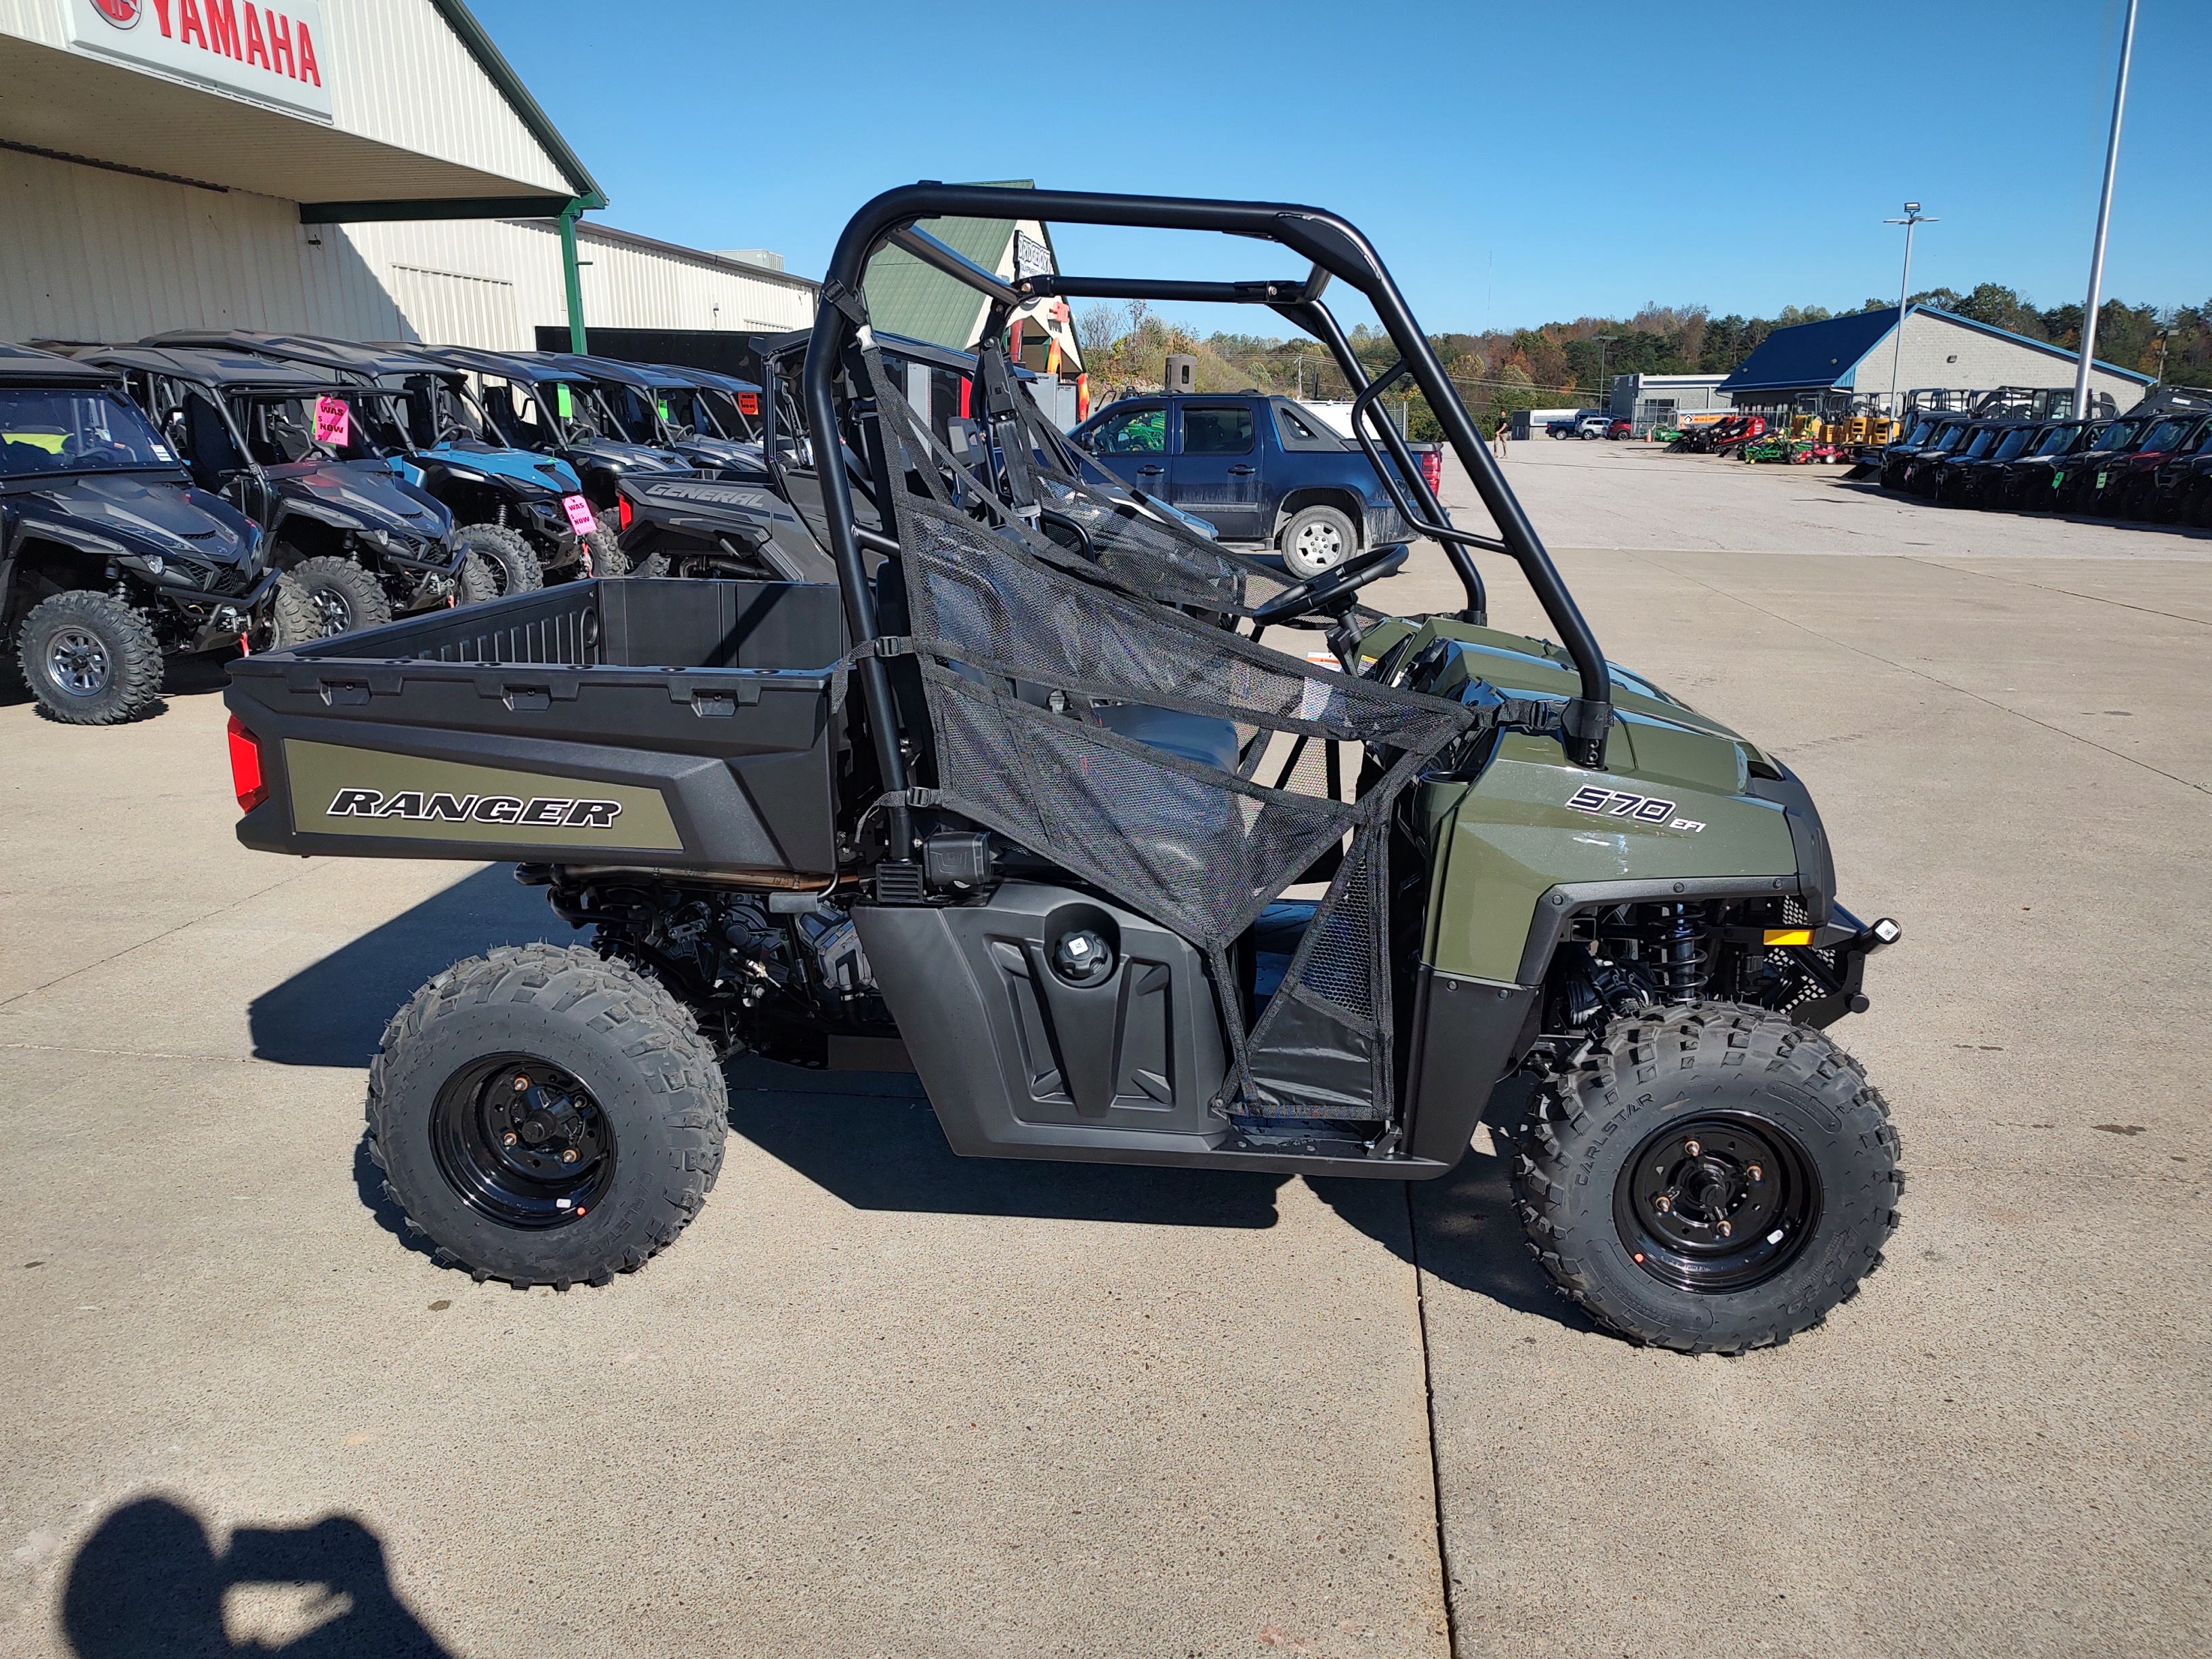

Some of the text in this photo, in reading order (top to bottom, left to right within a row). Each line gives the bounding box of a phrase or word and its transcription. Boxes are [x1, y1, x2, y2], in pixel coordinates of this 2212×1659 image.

[154, 0, 321, 87] YAMAHA
[321, 406, 344, 416] WAS
[320, 423, 344, 433] NOW
[569, 503, 585, 511] WAS
[645, 483, 765, 508] GENERAL
[574, 516, 590, 525] NOW
[326, 787, 623, 828] RANGER
[1565, 784, 1706, 833] 570 EFI
[1574, 1090, 1656, 1187] CARLSTAR
[586, 1171, 657, 1256] CARLSTAR
